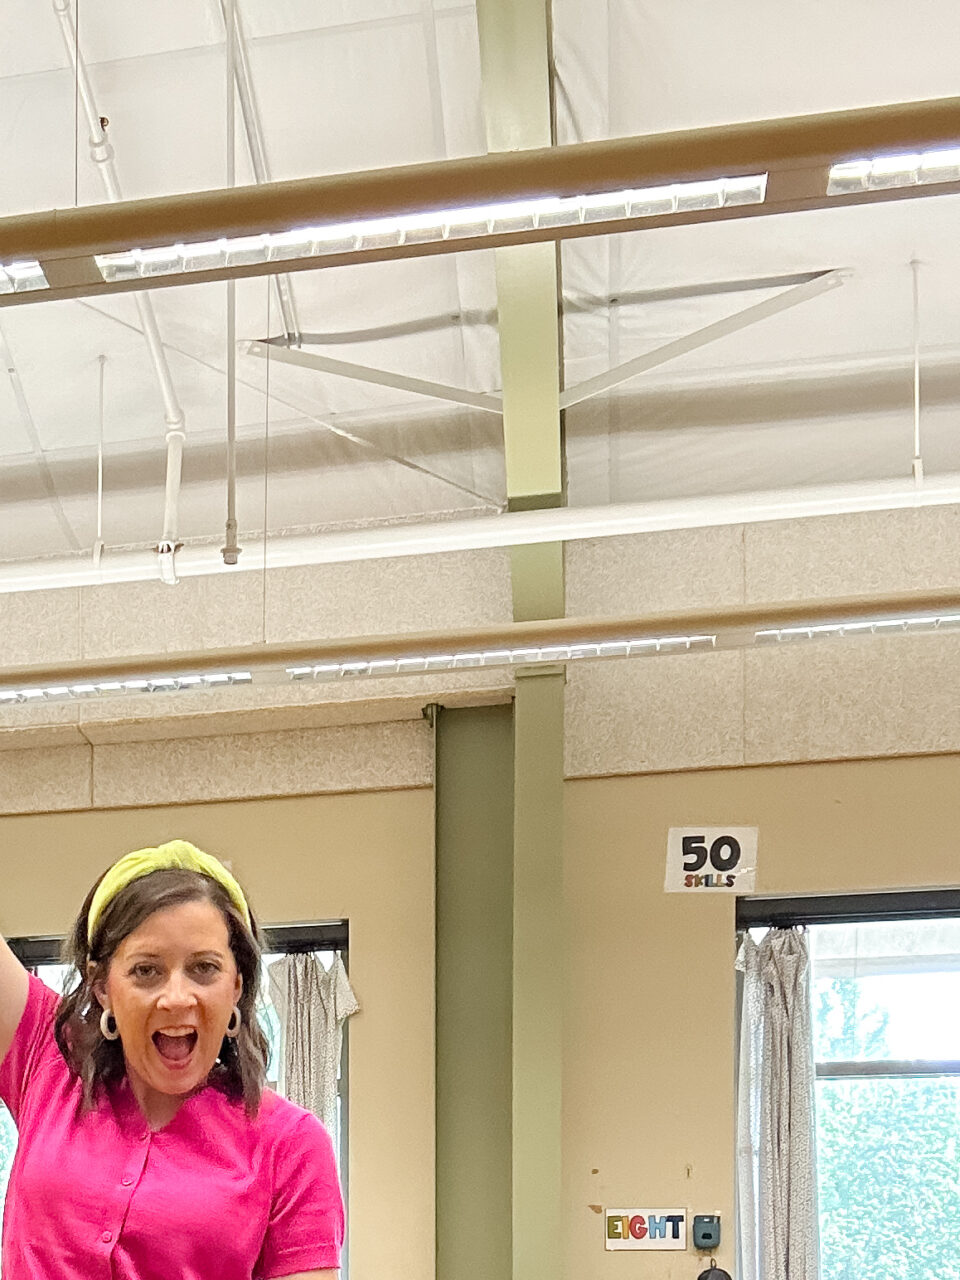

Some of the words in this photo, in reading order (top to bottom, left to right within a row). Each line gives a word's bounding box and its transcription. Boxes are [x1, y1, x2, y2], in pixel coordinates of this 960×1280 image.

[682, 836, 741, 872] 50
[684, 873, 737, 888] SKILLS
[607, 1215, 685, 1240] EIGHT
